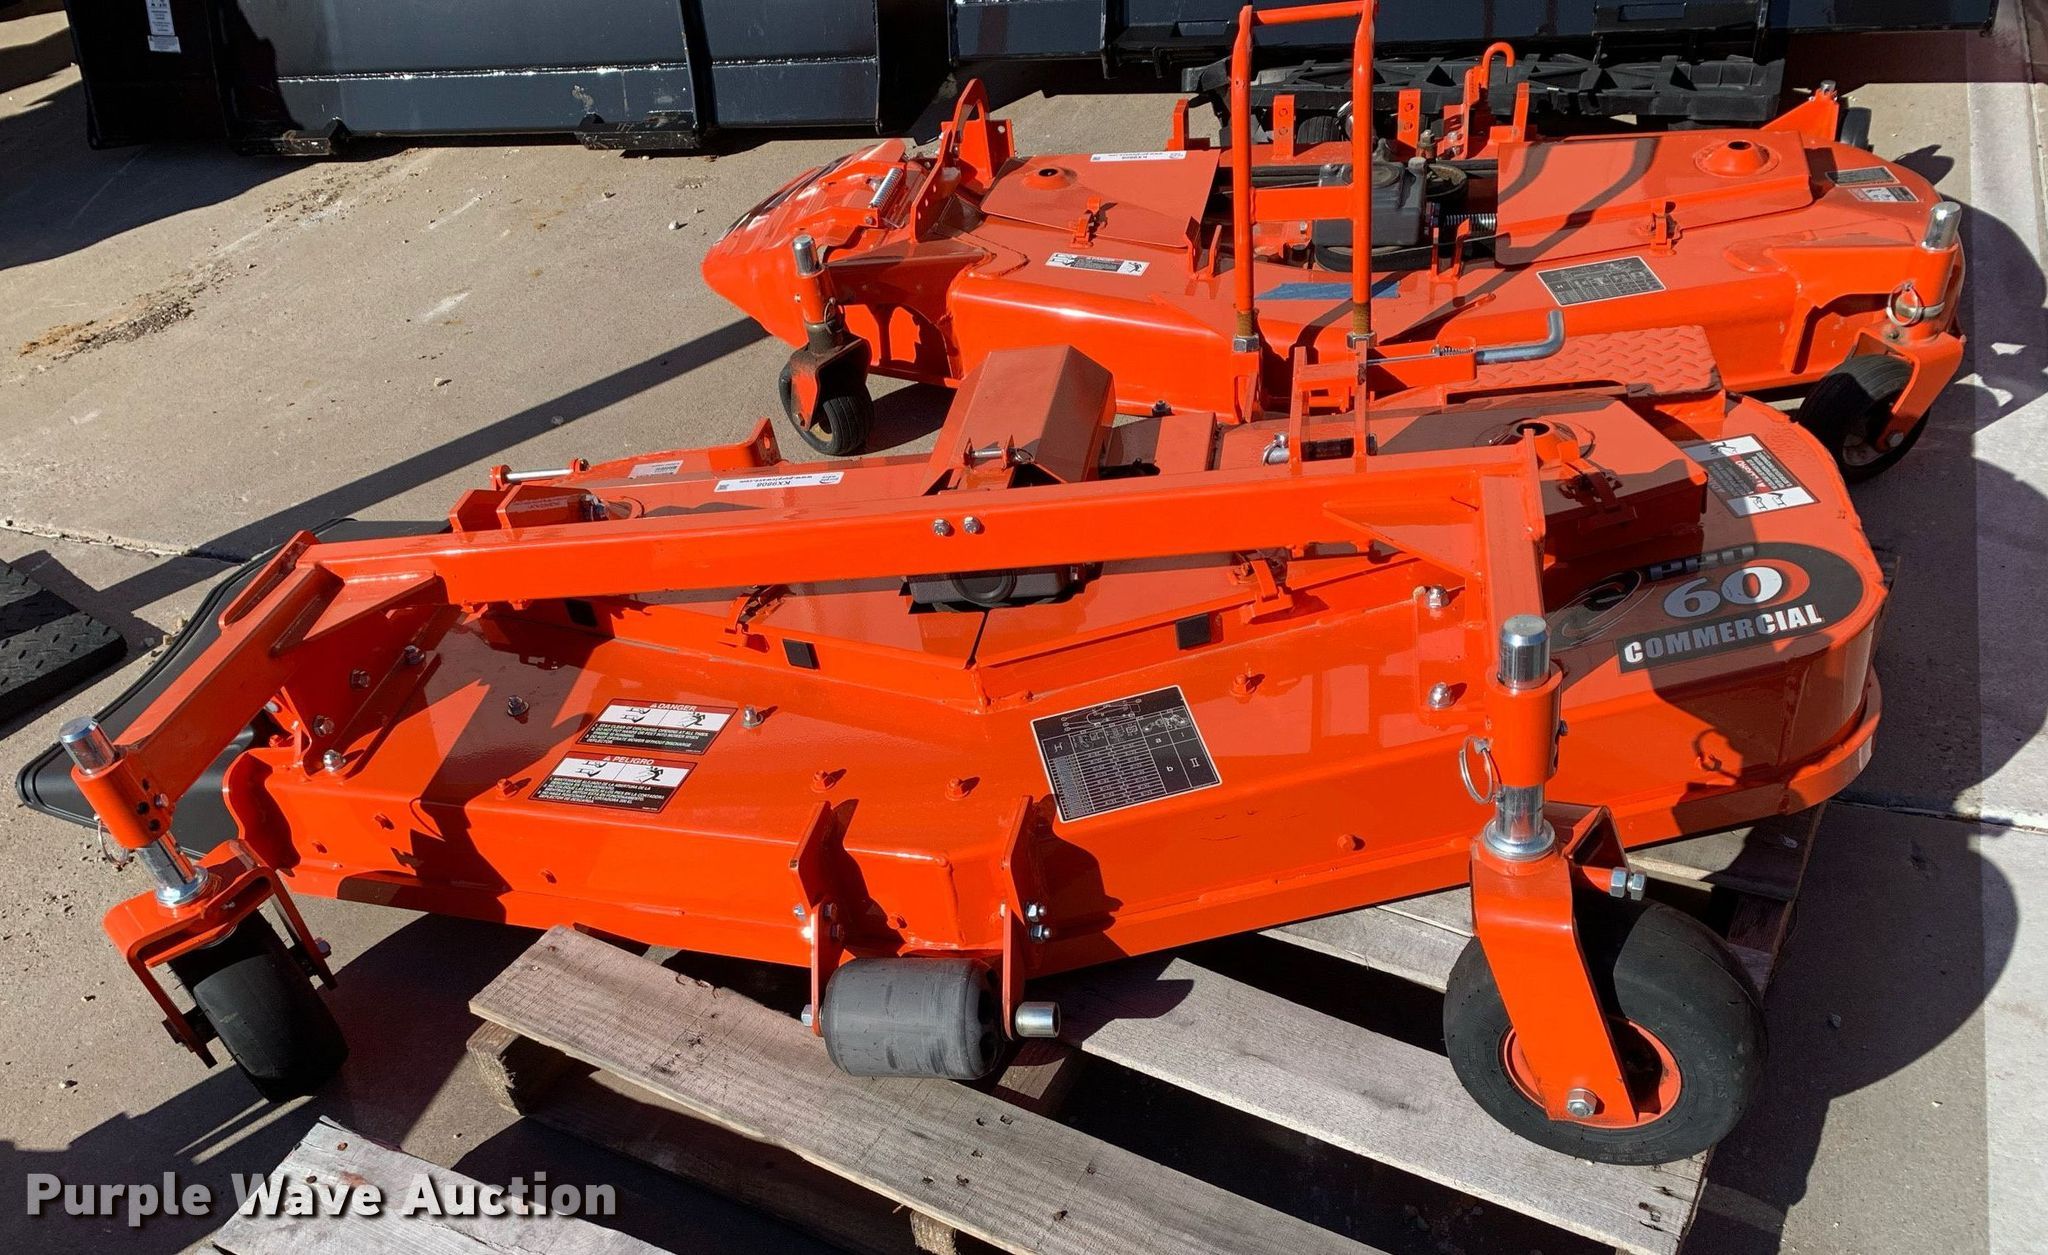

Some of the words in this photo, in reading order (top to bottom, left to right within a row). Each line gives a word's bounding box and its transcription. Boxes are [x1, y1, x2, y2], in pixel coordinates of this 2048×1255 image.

[1663, 566, 1783, 618] 60
[1623, 604, 1823, 664] COMMERCIAL
[657, 703, 698, 712] DANGER
[612, 756, 654, 766] PELIGRO
